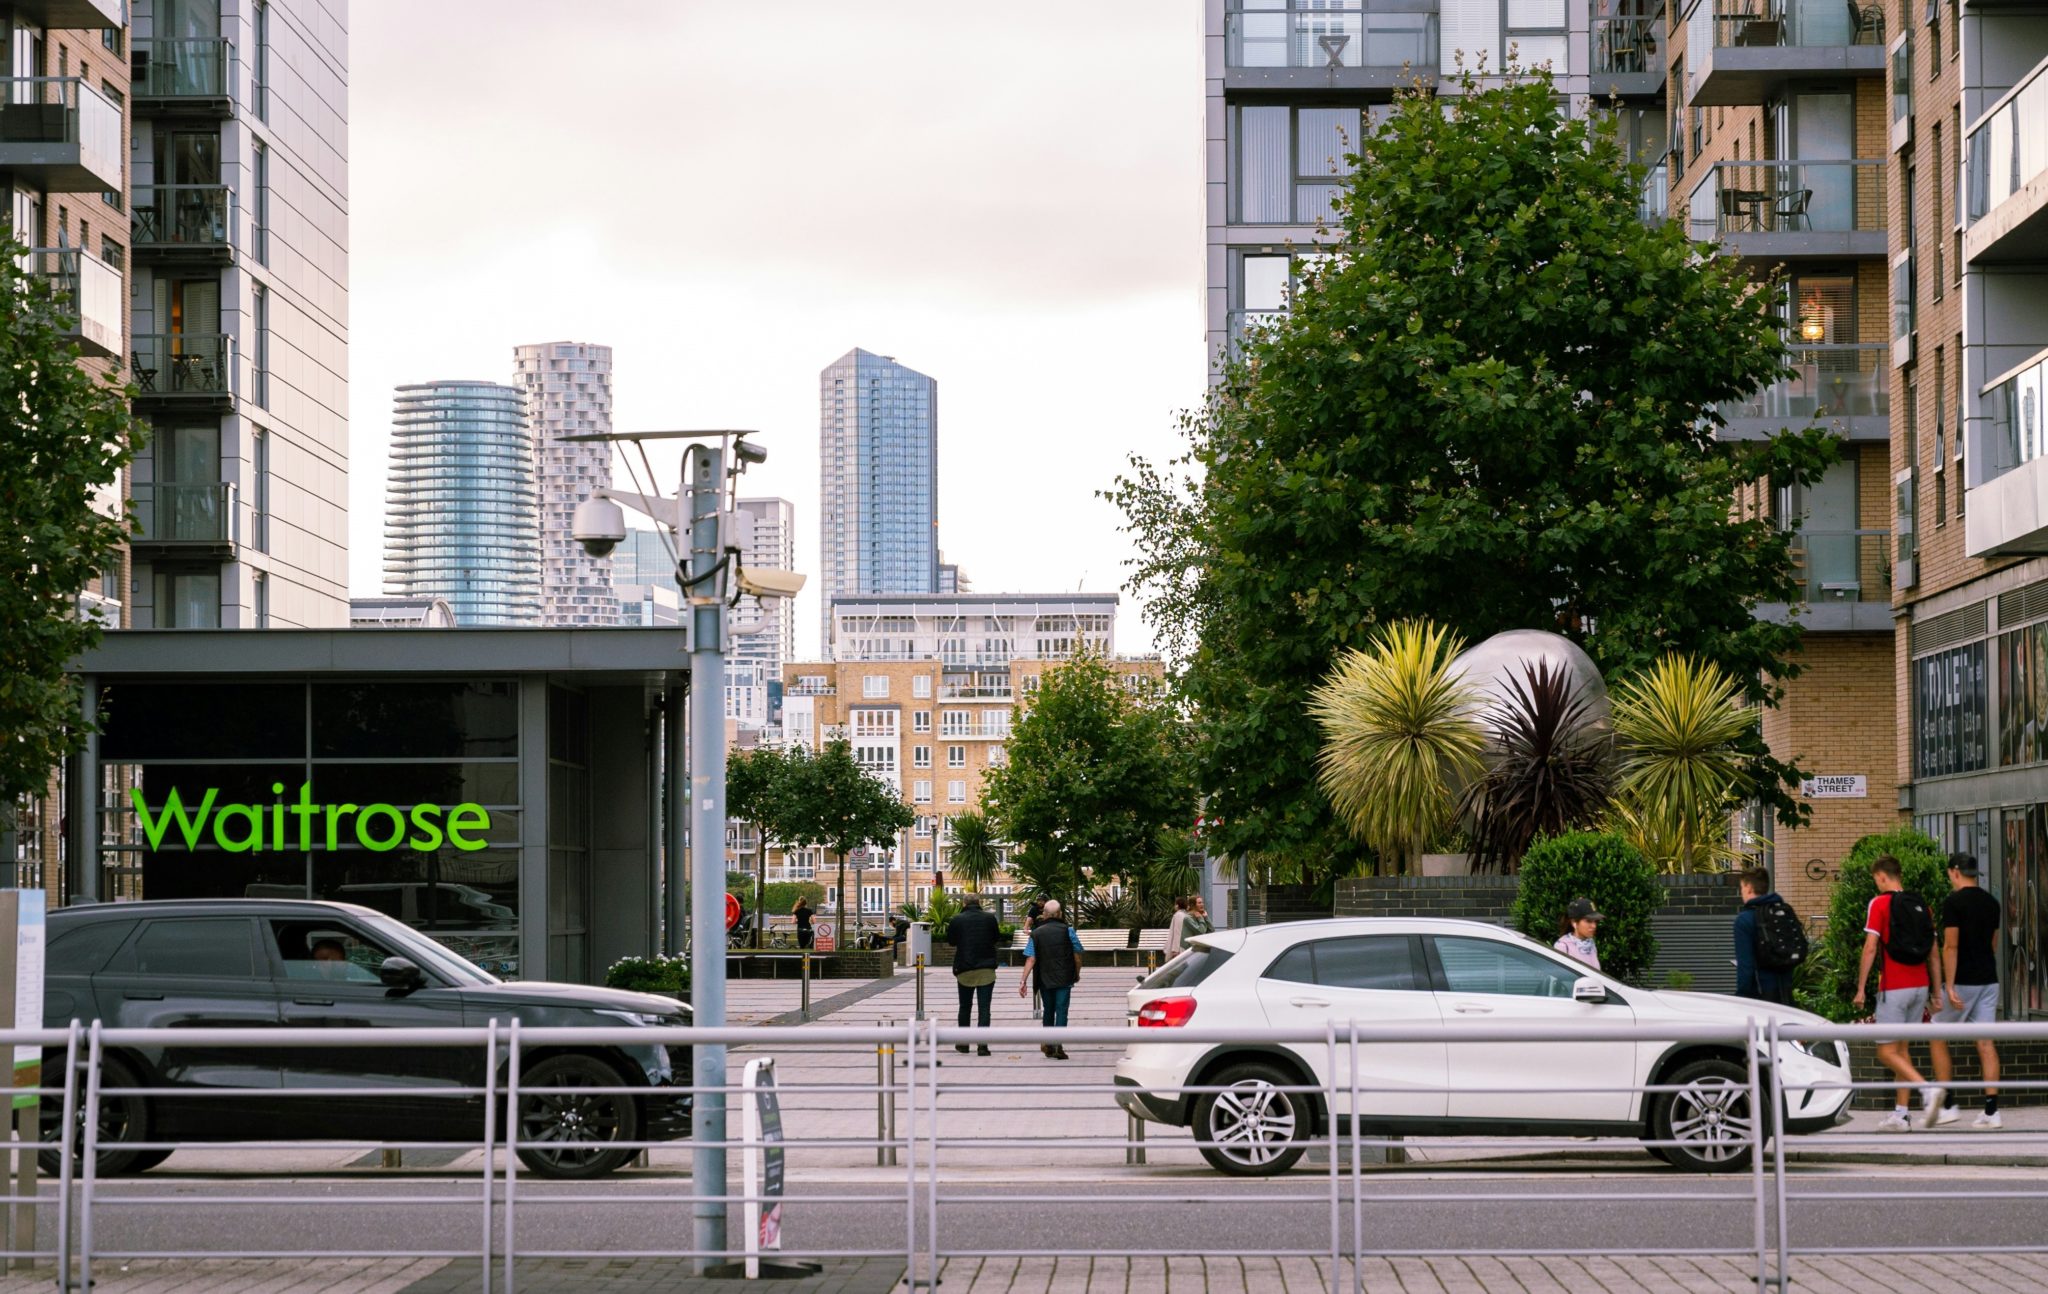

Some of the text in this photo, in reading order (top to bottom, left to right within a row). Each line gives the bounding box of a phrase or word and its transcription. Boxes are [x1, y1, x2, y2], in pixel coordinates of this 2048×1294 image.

[1817, 777, 1856, 785] THAMES
[1817, 785, 1854, 793] STREET
[129, 779, 491, 853] Waitrose
